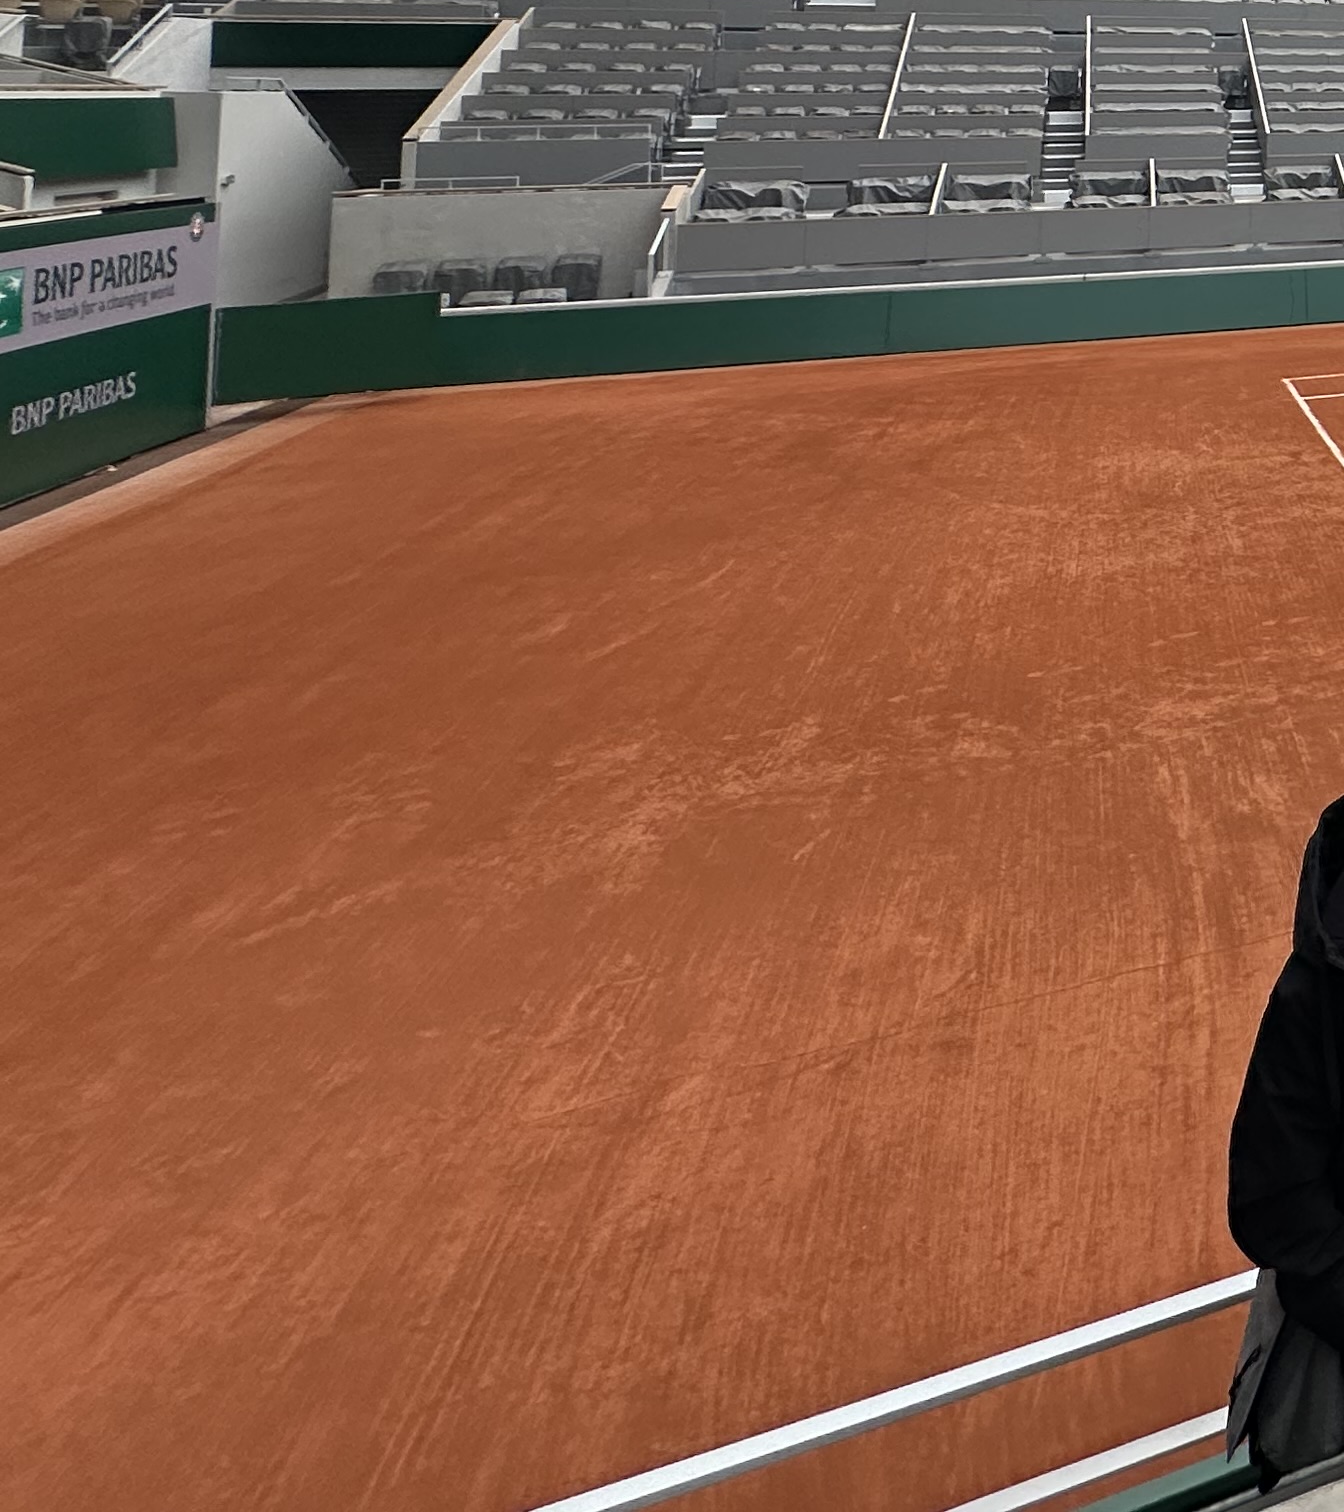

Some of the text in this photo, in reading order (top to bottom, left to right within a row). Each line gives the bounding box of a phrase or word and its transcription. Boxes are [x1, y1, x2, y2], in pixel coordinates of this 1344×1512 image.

[32, 245, 178, 306] BNP PARIBAS
[11, 371, 137, 435] BNP PARIBAS
